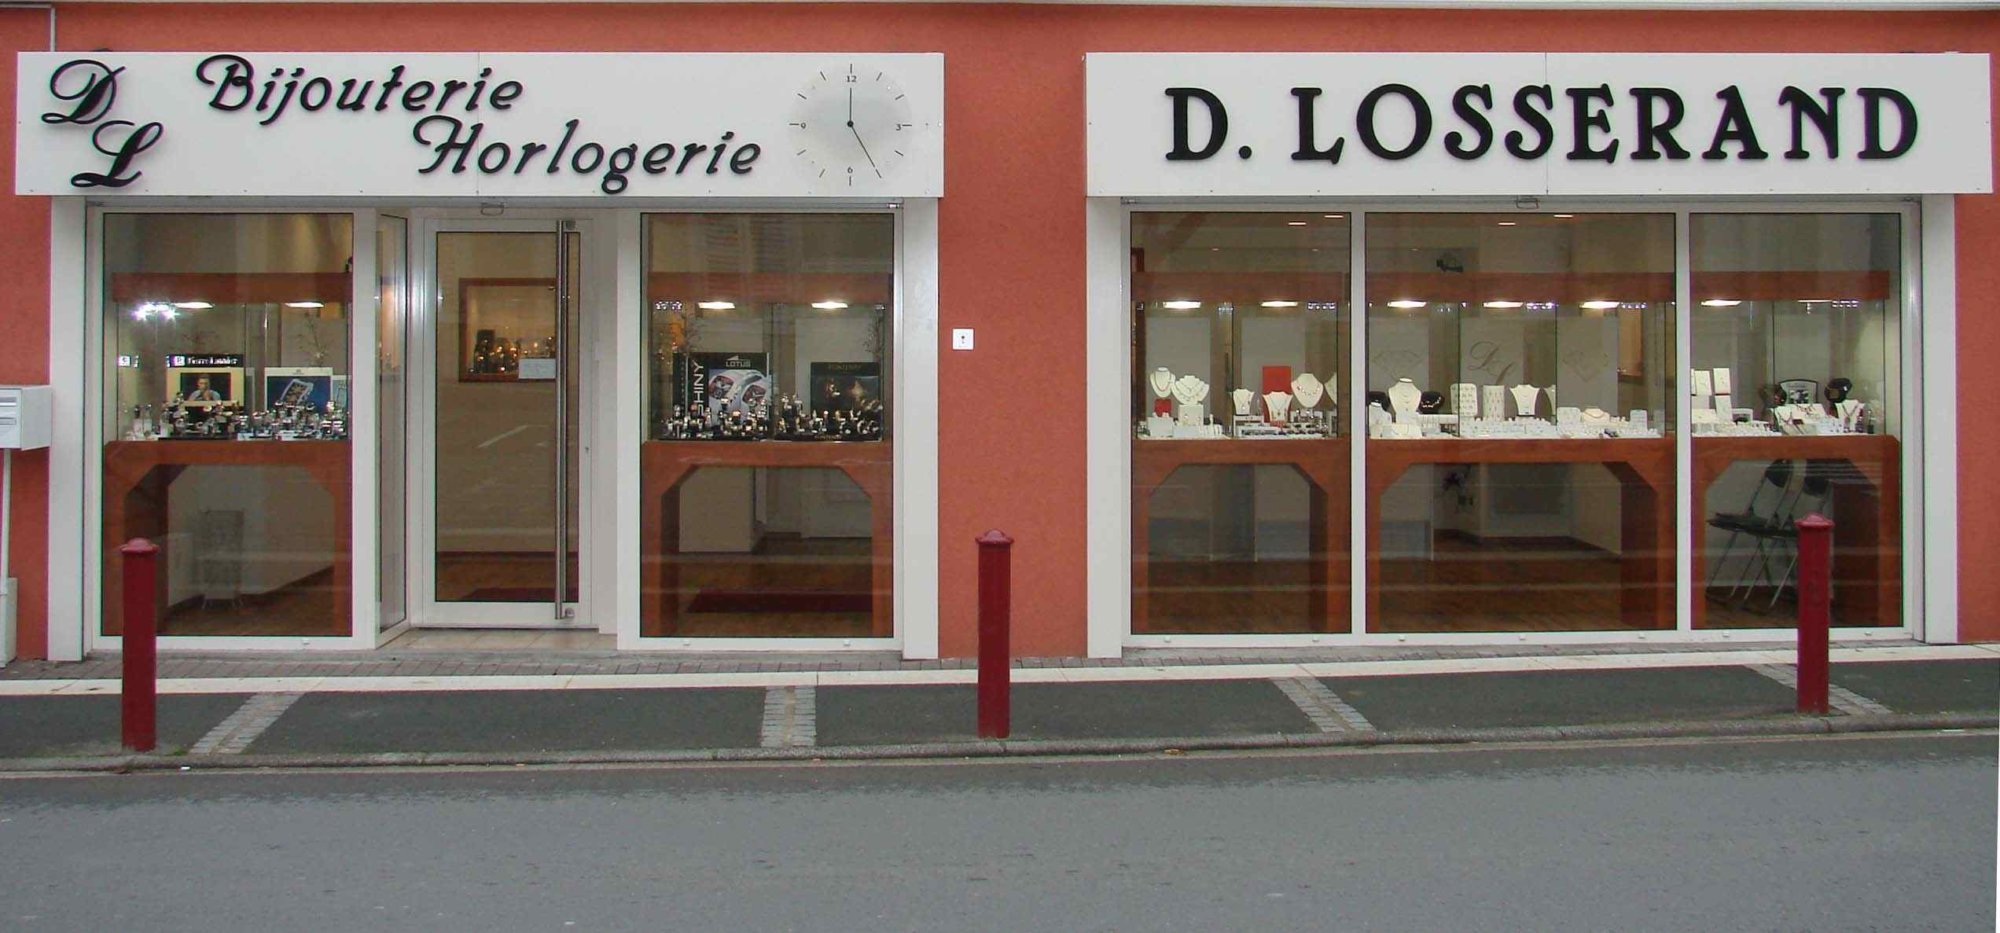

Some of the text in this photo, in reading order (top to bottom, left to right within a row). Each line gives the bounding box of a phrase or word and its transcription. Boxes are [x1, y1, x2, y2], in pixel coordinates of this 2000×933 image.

[41, 59, 126, 125] D
[196, 54, 523, 127] Bijouterie
[846, 75, 857, 83] 12
[412, 114, 761, 195] Horlogerie
[1164, 83, 1918, 166] D. LOSSERAND
